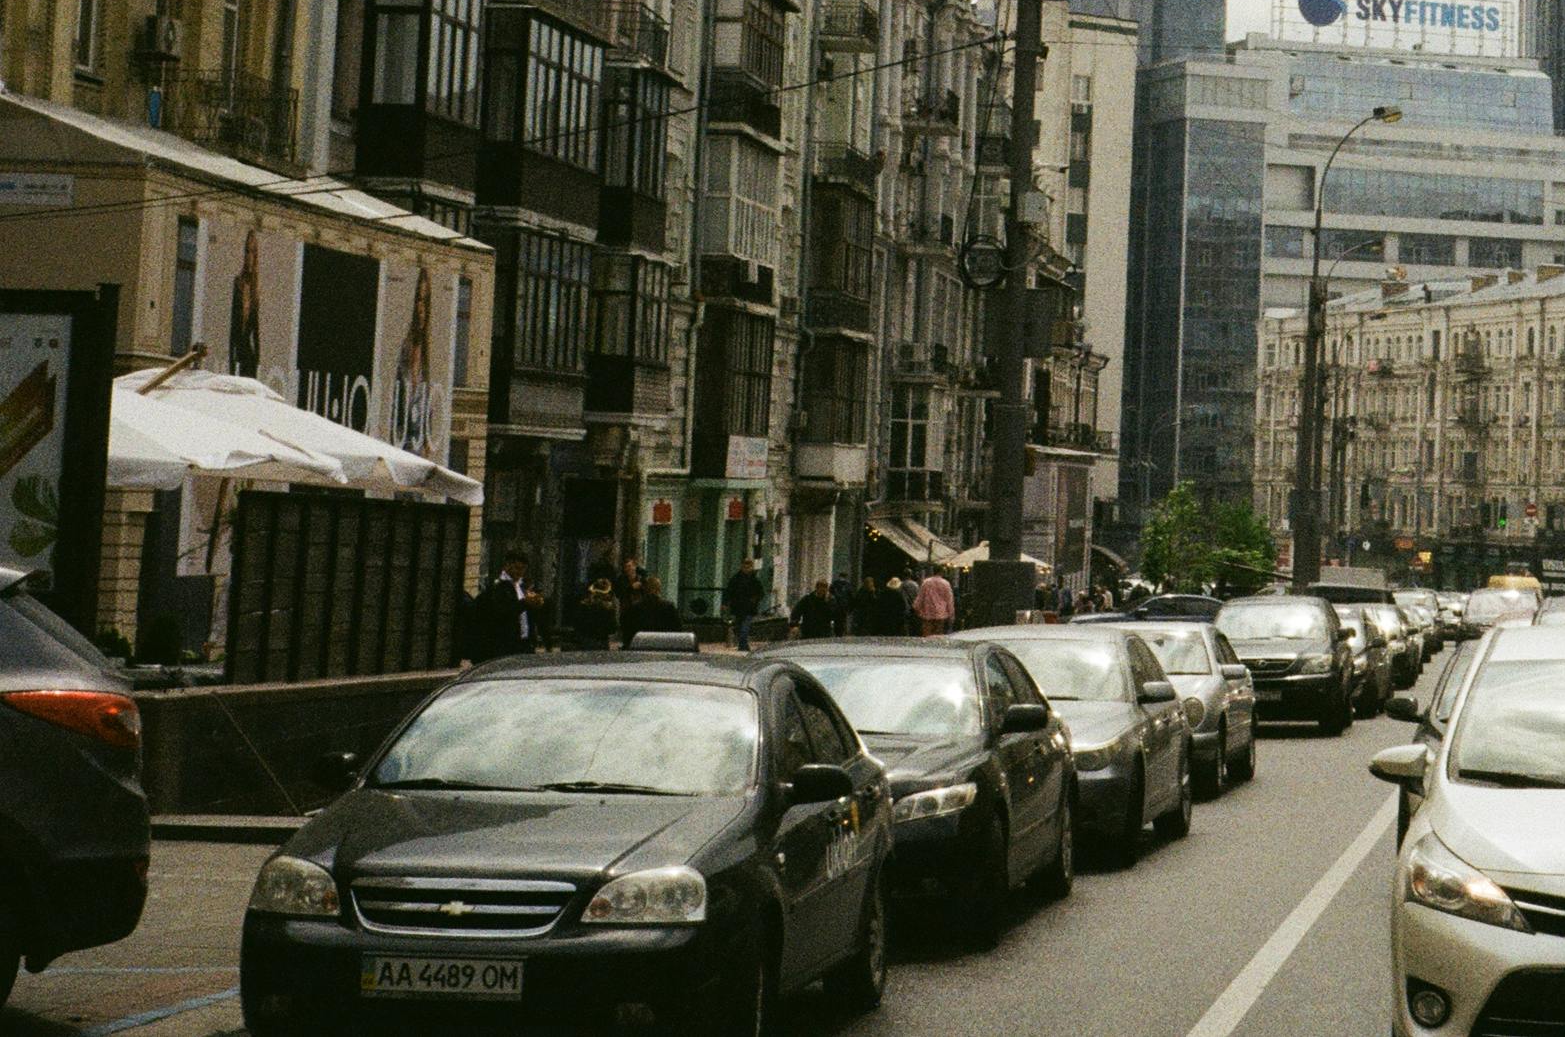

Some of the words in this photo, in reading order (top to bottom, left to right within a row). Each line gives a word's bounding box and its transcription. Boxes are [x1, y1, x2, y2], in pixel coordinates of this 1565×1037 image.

[377, 961, 413, 988] AA
[419, 963, 476, 989] 4489
[482, 964, 518, 990] OM
